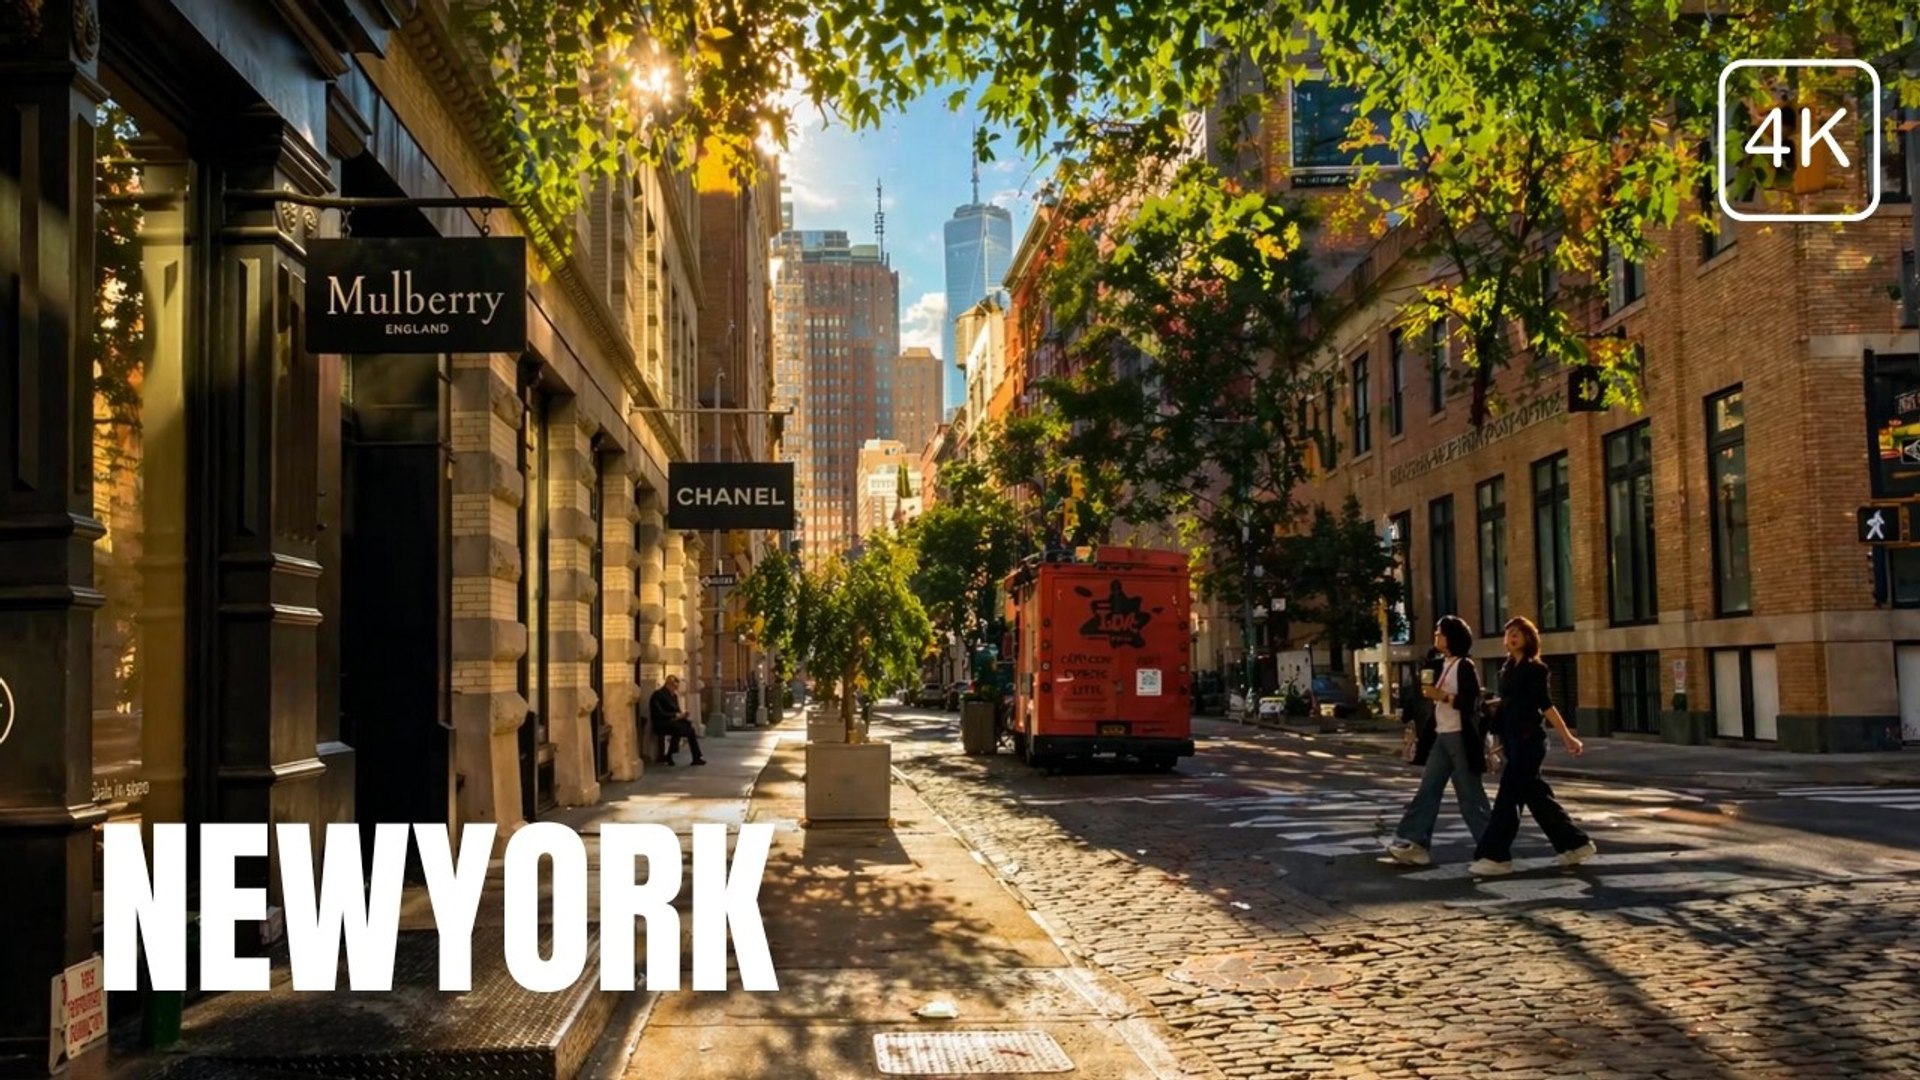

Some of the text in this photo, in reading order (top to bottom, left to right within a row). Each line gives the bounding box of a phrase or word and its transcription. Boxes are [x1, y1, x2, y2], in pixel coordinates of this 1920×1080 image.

[327, 269, 504, 325] Mulberry
[385, 323, 450, 335] ENGLAND
[676, 487, 786, 506] CHANEL
